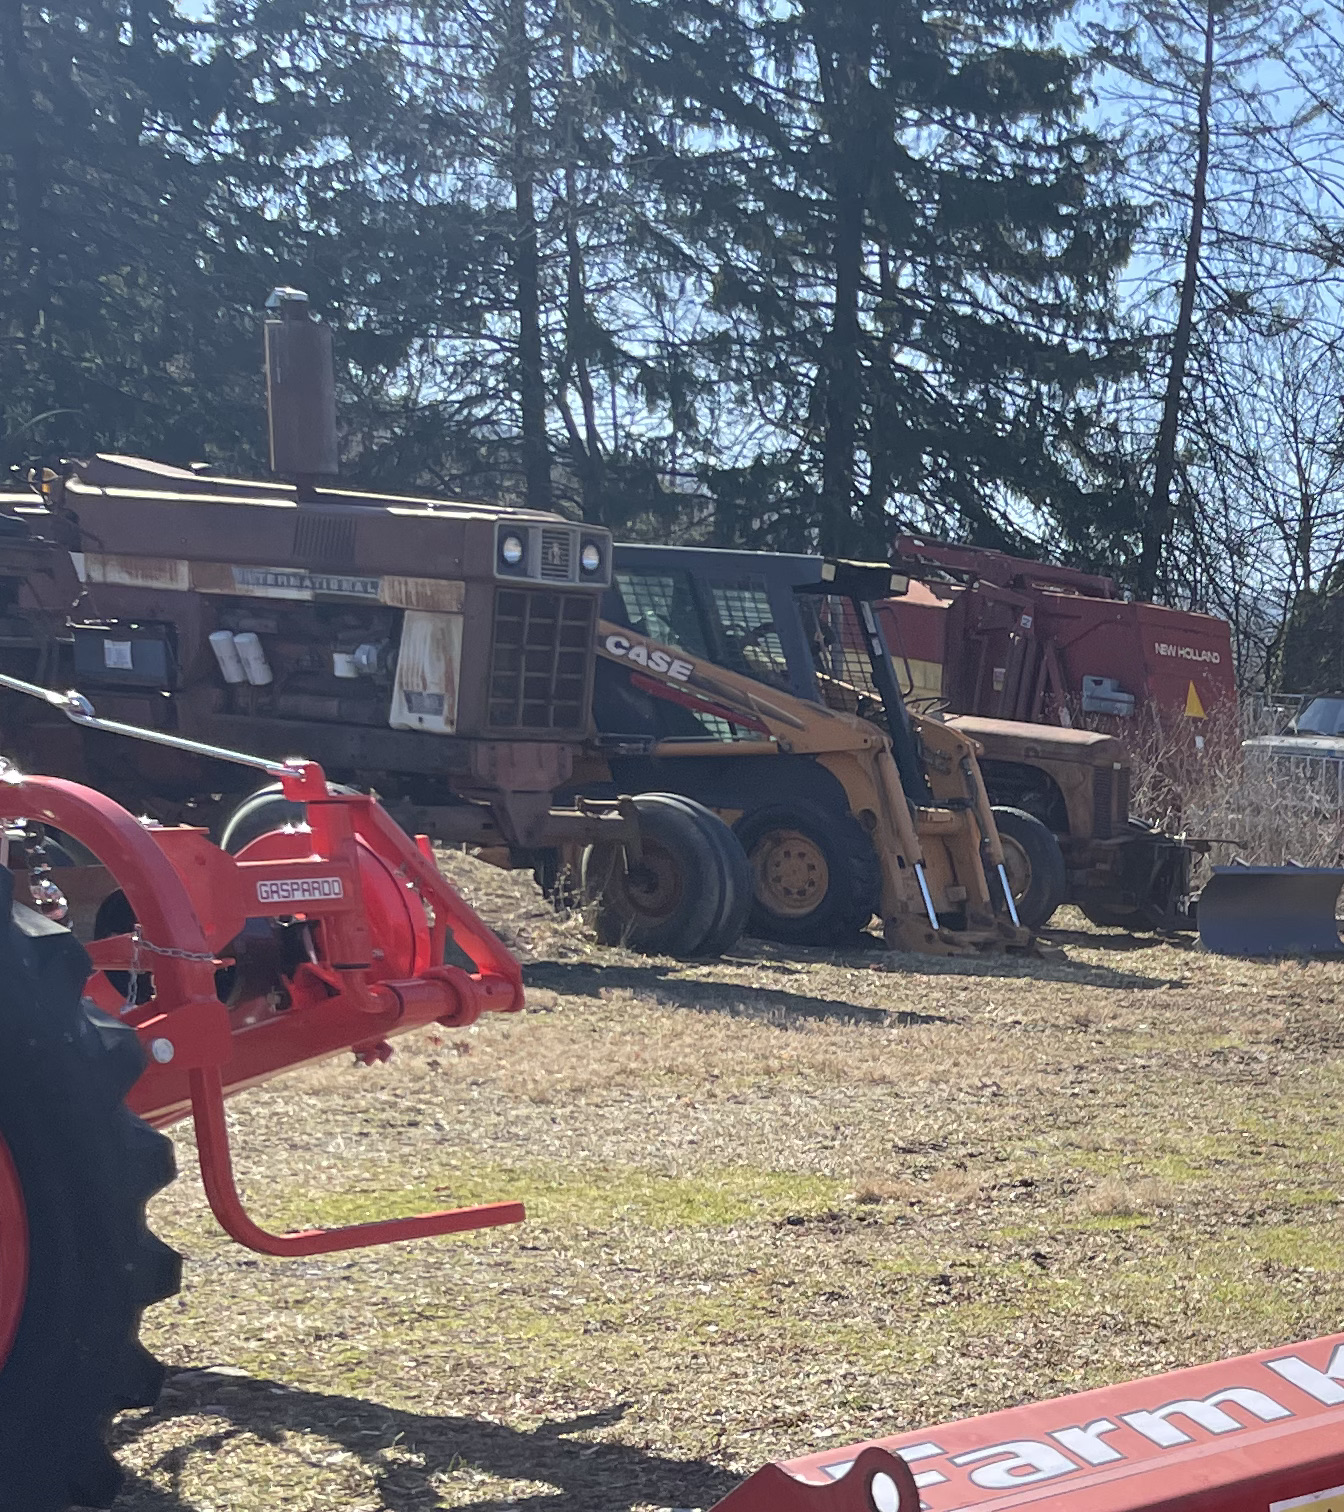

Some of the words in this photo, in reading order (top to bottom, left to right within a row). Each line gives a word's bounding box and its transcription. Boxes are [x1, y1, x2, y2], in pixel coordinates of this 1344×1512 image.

[606, 635, 694, 681] CASE
[1155, 642, 1176, 657] NEW
[1178, 647, 1221, 664] HOLLAND
[258, 880, 341, 899] GASPARDO
